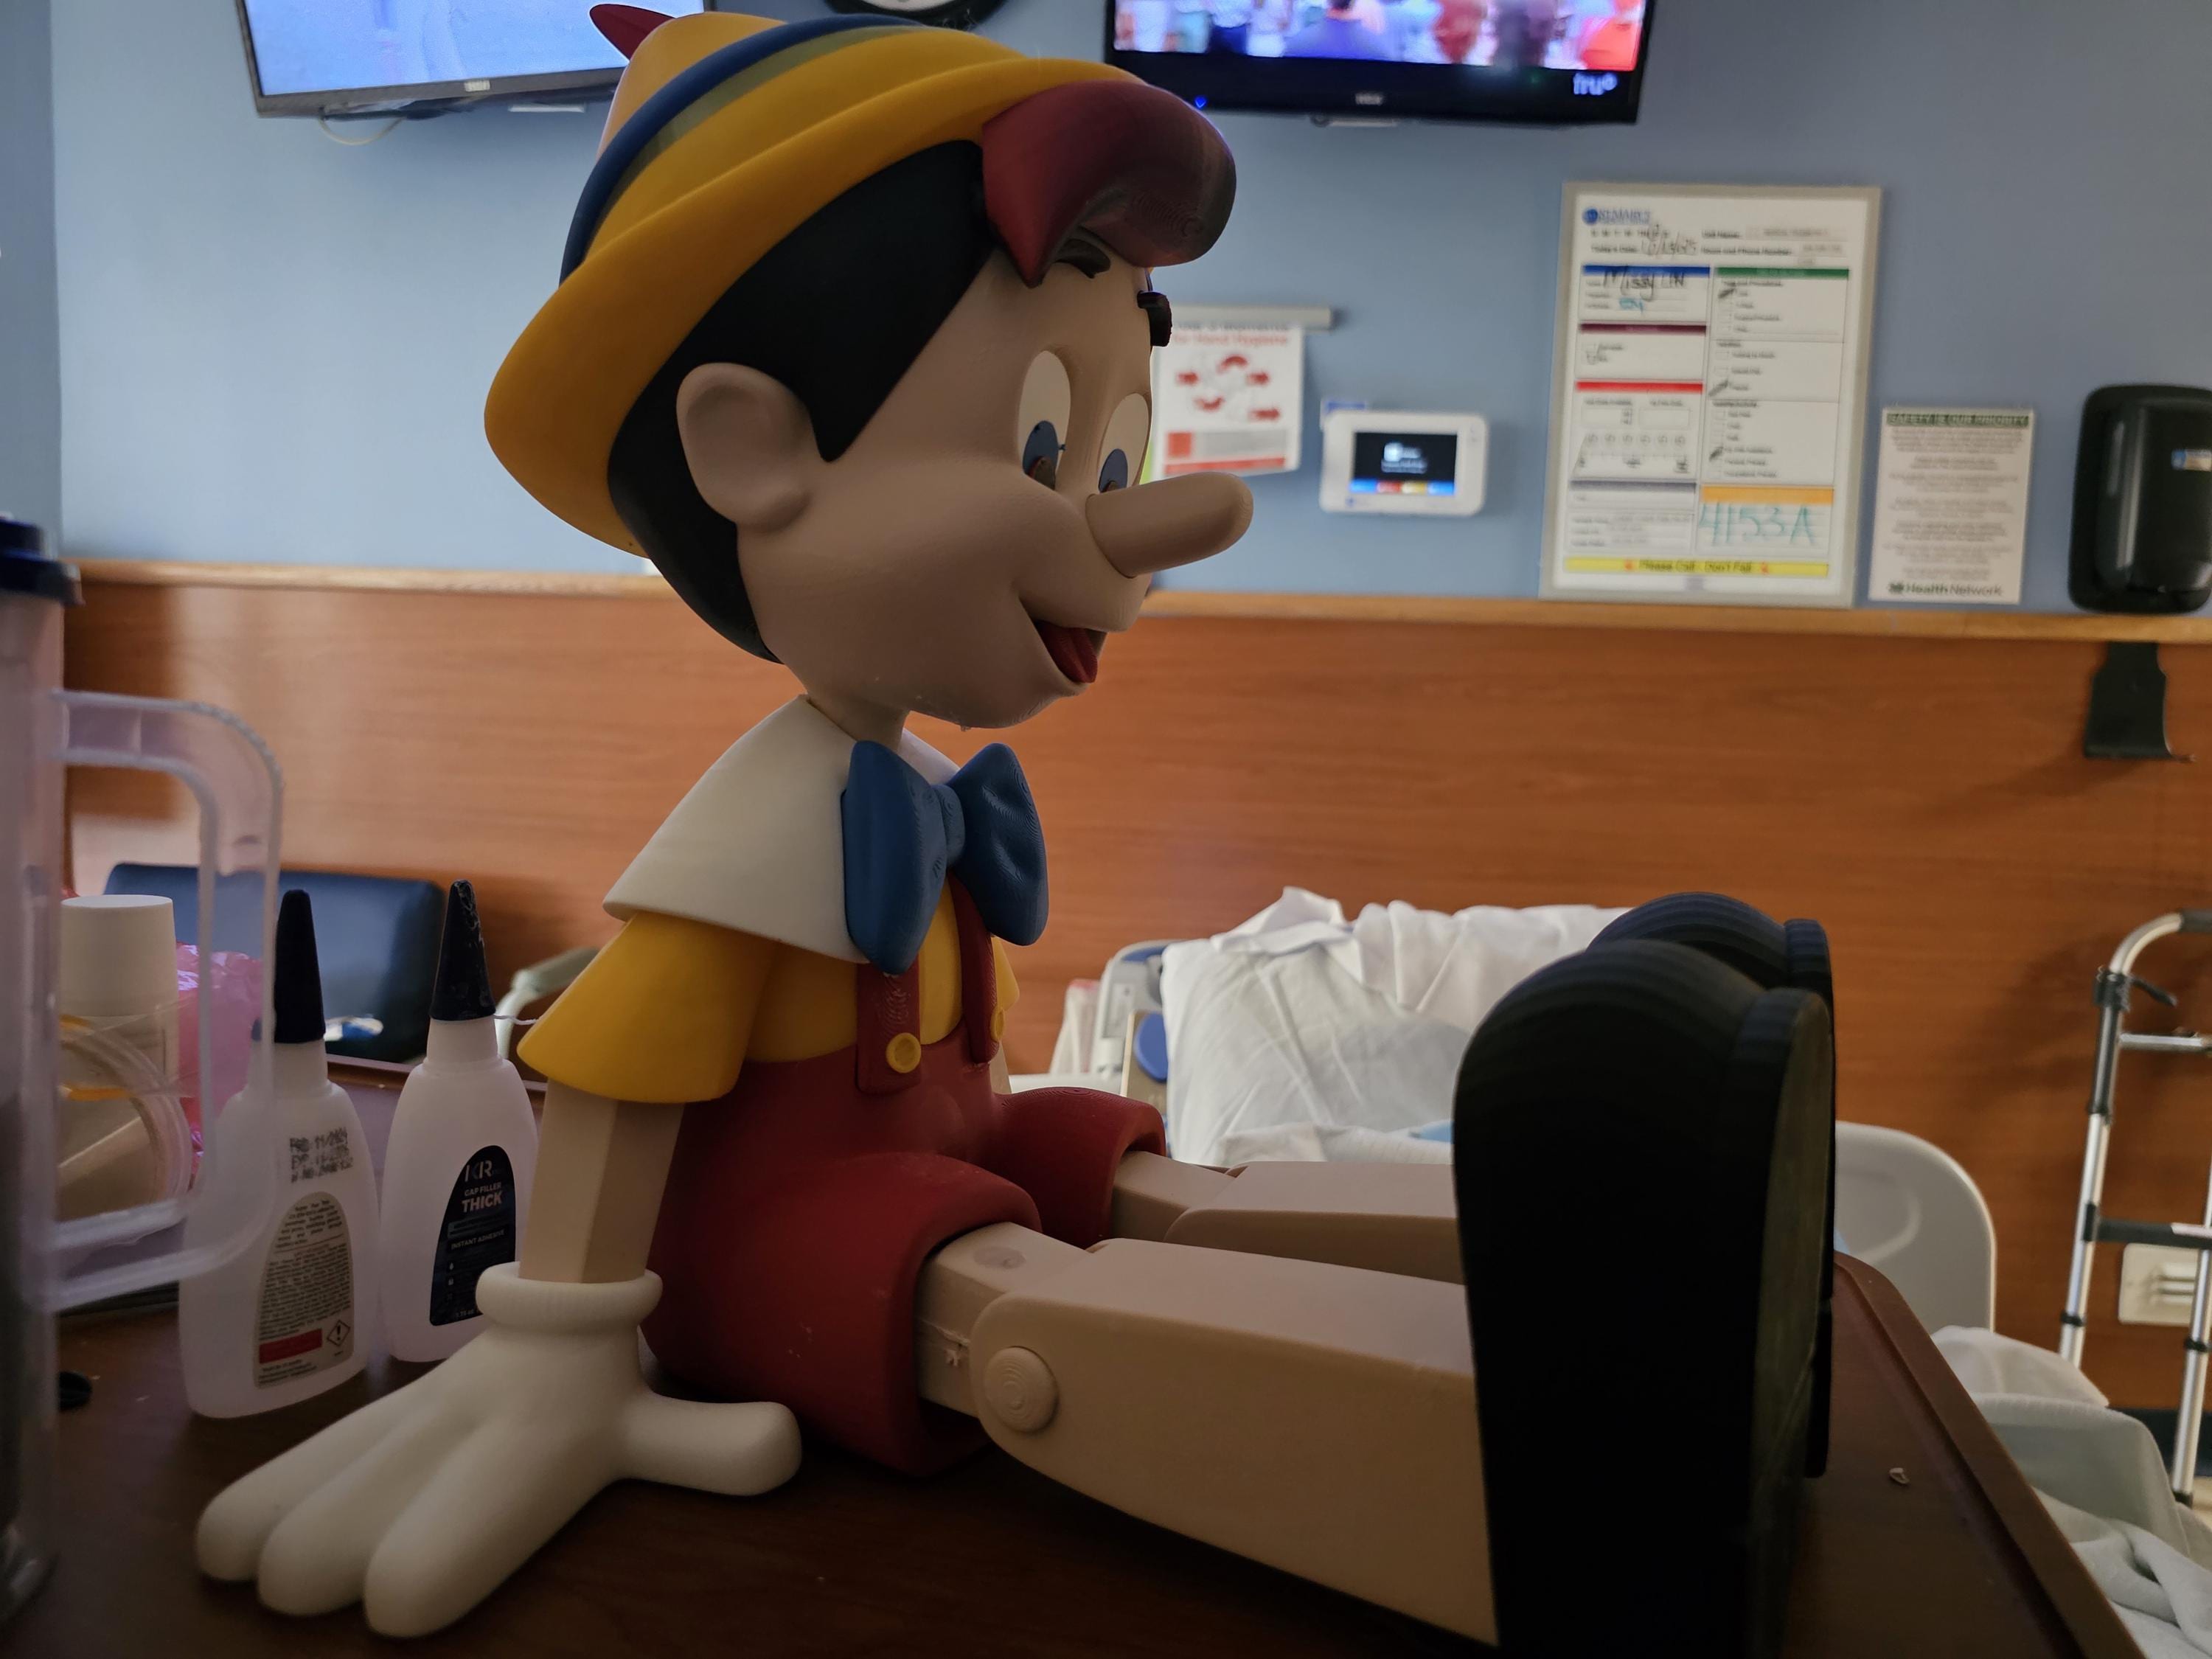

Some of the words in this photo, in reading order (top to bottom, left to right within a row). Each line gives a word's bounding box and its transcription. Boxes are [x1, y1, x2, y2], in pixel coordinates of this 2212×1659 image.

[464, 1186, 479, 1197] GAP
[480, 1181, 502, 1193] FILLER
[462, 1190, 503, 1213] THICK
[451, 1237, 478, 1251] INSTANT
[478, 1228, 505, 1242] ADHESIVE
